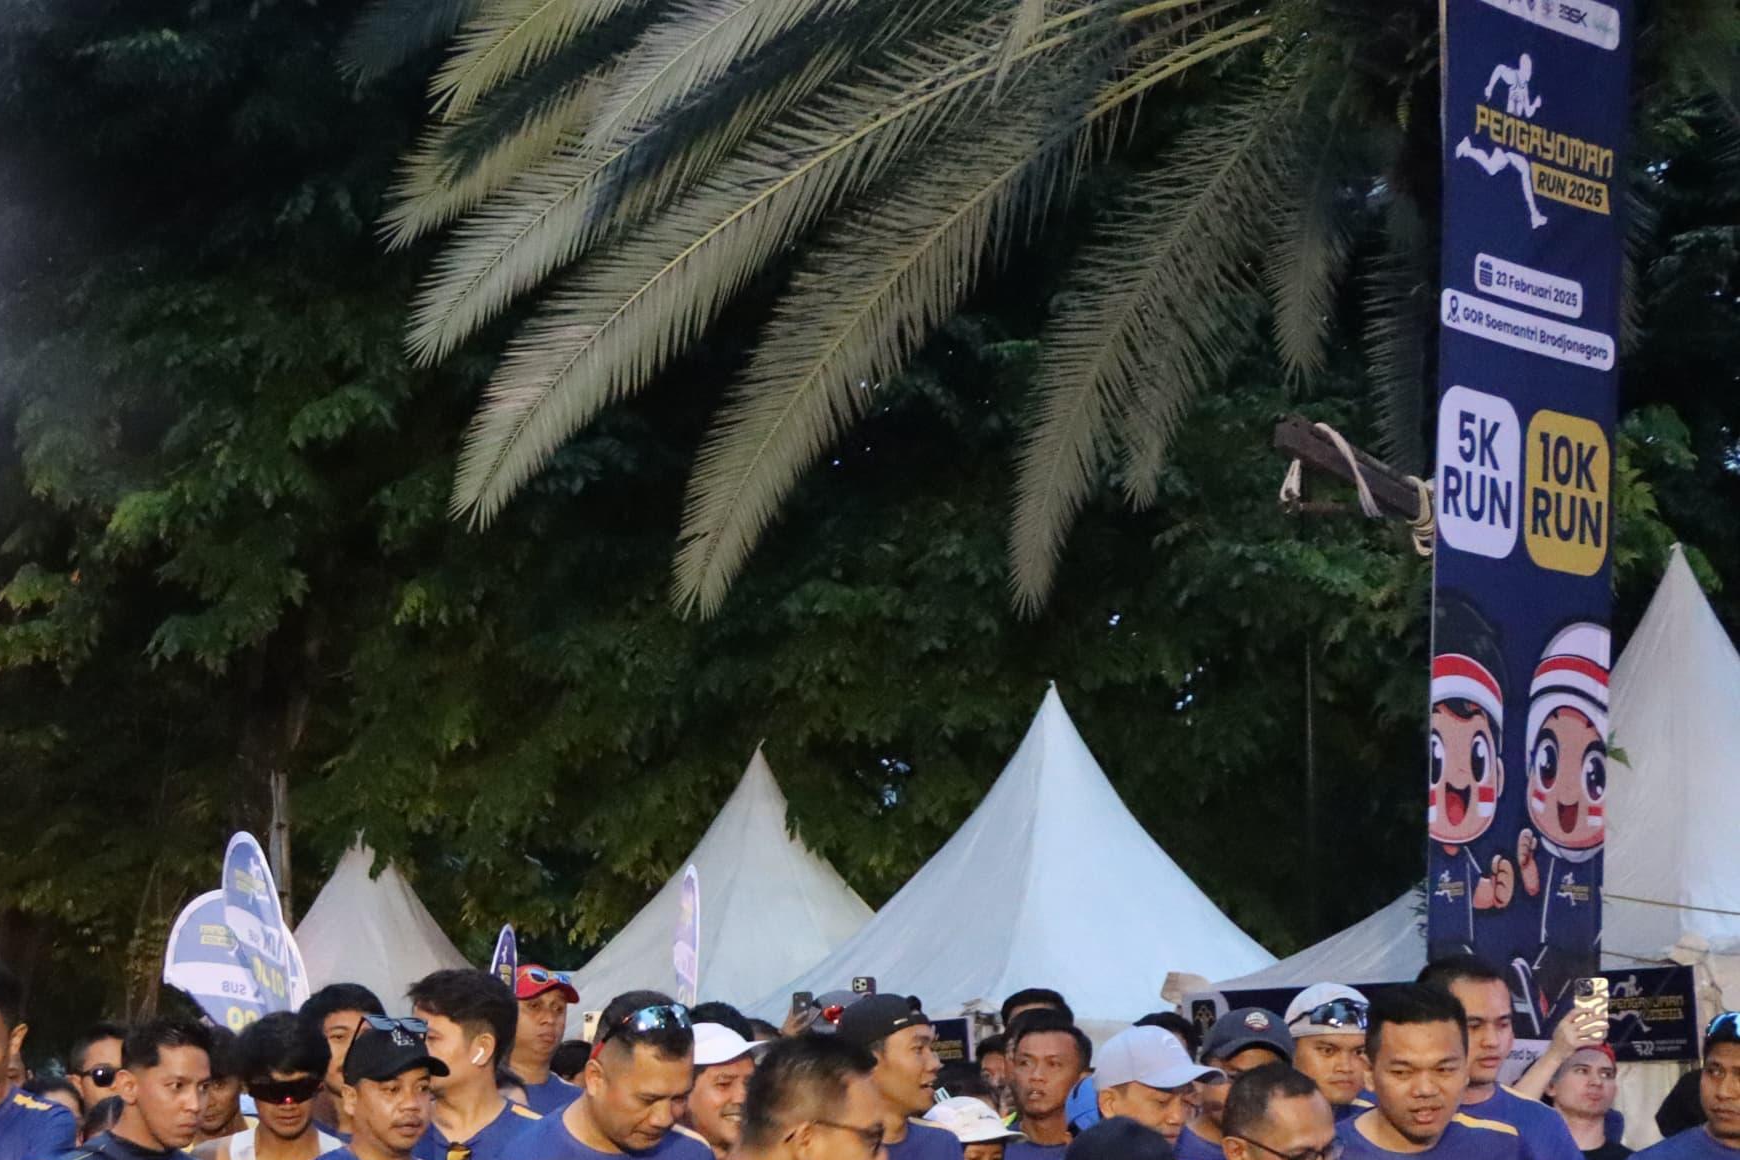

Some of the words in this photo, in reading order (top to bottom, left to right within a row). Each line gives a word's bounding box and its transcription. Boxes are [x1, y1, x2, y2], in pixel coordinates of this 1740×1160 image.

[1475, 104, 1613, 178] PENGAYOMAN
[1537, 171, 1566, 198] RUN
[1568, 181, 1603, 207] 2025
[1495, 271, 1507, 286] 23
[1509, 275, 1552, 301] Februari
[1553, 288, 1578, 307] 2025
[1463, 307, 1483, 324] GOR
[1485, 313, 1539, 342] Soemantri
[1539, 330, 1609, 361] Brodjonegoro
[1458, 410, 1501, 471] 5K
[1539, 431, 1598, 493] 10K
[1443, 465, 1512, 529] RUN
[1532, 487, 1602, 548] RUN
